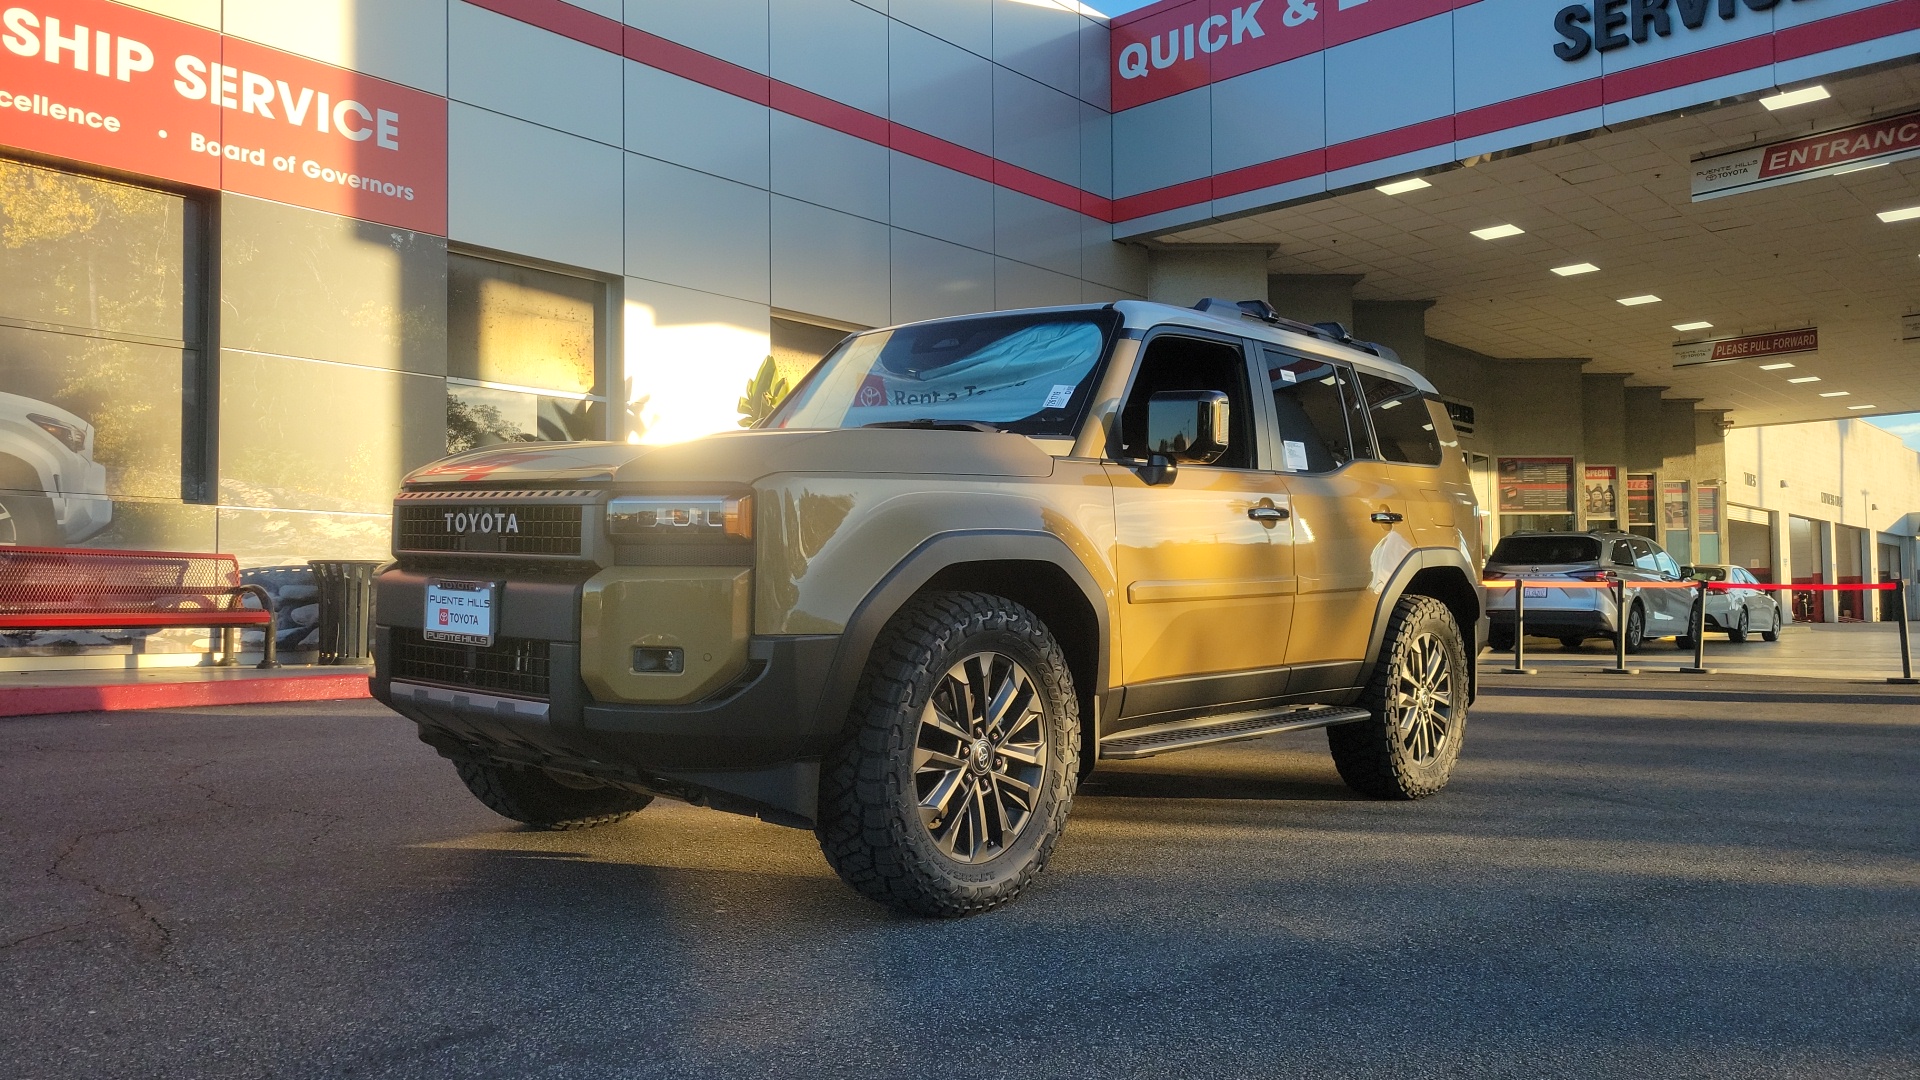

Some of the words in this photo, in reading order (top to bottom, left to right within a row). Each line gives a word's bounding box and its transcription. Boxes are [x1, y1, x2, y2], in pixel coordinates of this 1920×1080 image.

[1118, 0, 1265, 80] QUICK
[1, 7, 155, 83] SHIP
[173, 54, 399, 152] SERVICE
[190, 132, 266, 167] Board
[272, 155, 297, 174] of
[302, 160, 415, 201] Governors
[1696, 165, 1732, 177] PUENTE
[1735, 159, 1758, 169] HILLS
[1717, 168, 1749, 179] TOYOTA
[1716, 343, 1748, 356] PLEASE
[1750, 340, 1771, 352] PULL
[1773, 334, 1816, 349] FORWARD
[894, 390, 940, 406] Rent
[444, 512, 519, 534] TOYOTA
[440, 581, 476, 590] TOYOTA
[429, 594, 464, 606] PUENTE
[467, 597, 491, 608] HILLS
[449, 612, 479, 626] TOYOTA
[427, 631, 461, 642] PUENTE
[461, 635, 487, 645] HILLS
[1036, 661, 1065, 764] COUNTRY
[1045, 769, 1063, 818] R/T
